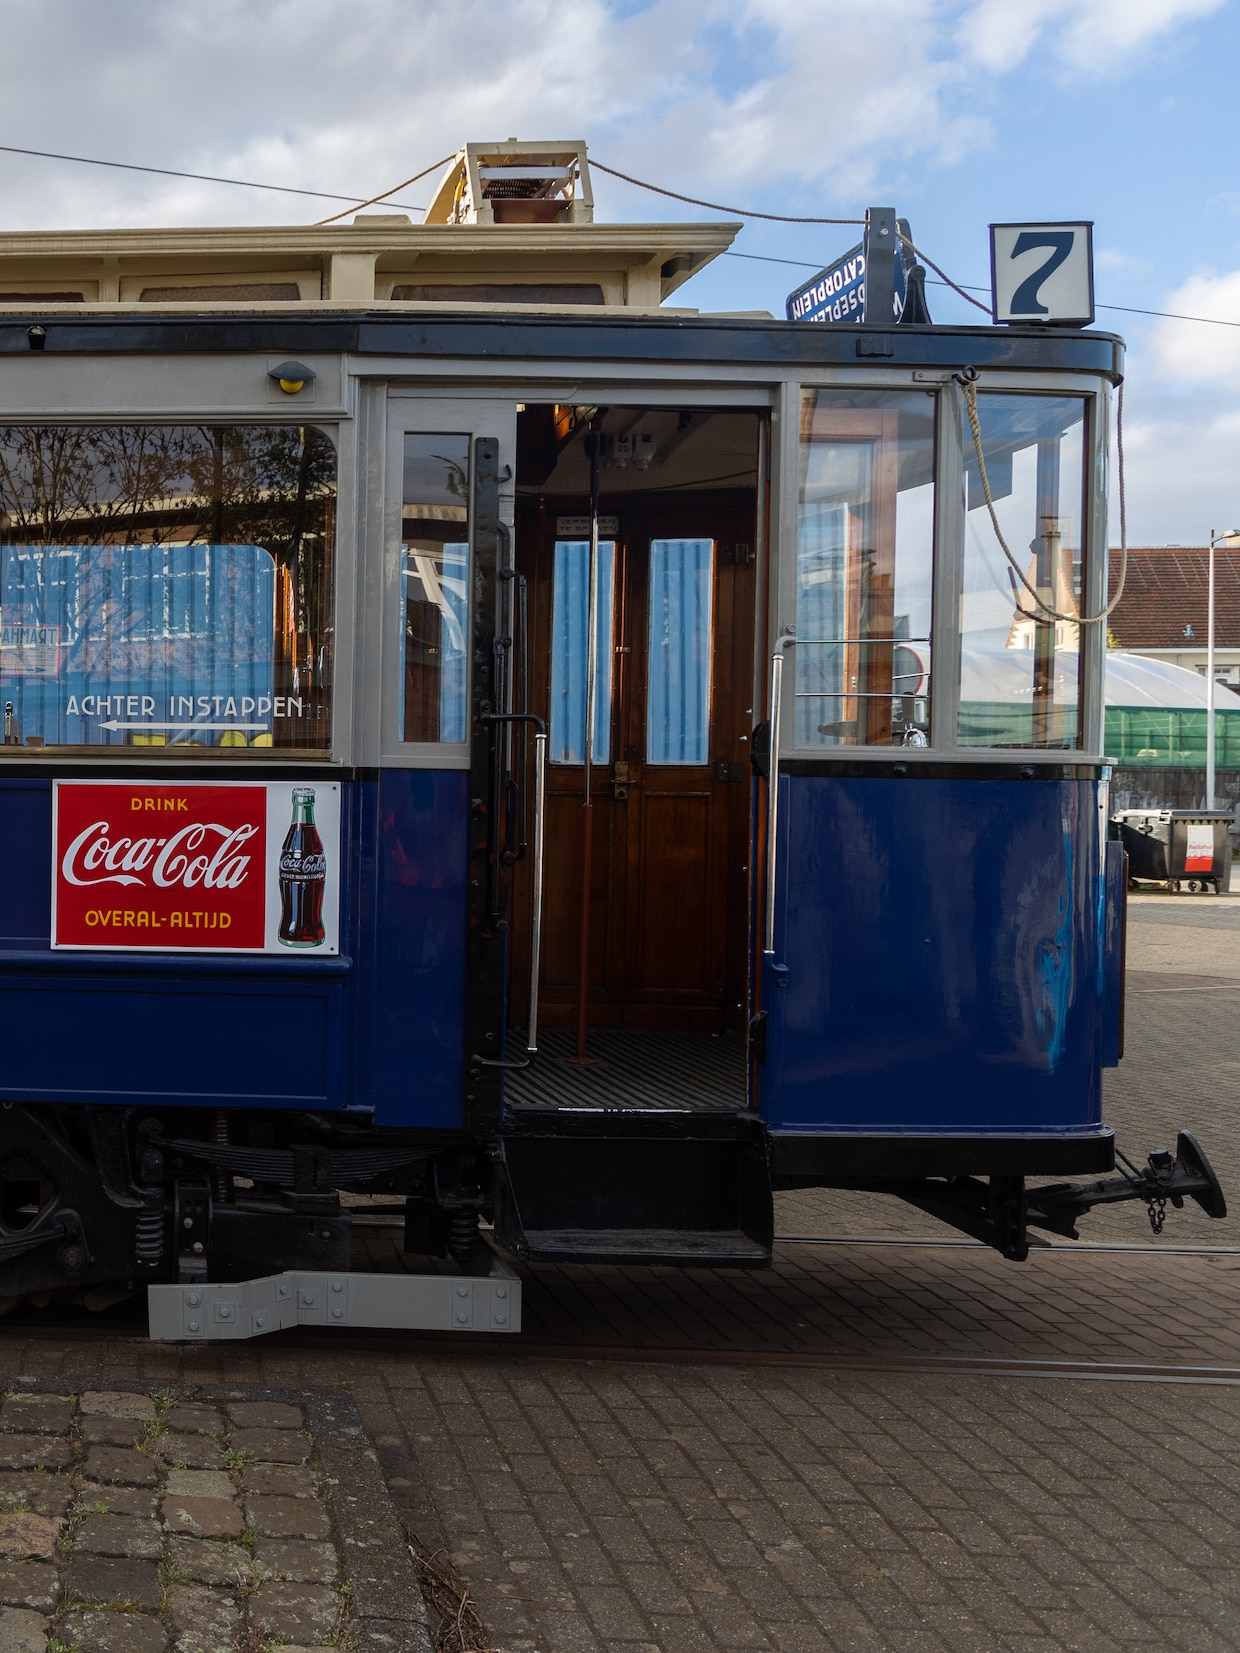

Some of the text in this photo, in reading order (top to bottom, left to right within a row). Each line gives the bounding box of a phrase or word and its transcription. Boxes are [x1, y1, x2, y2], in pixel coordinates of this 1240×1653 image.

[791, 255, 866, 319] CATORPLEIN
[1010, 231, 1075, 315] 7
[66, 695, 303, 719] ACHTER INSTAPPEN
[131, 798, 189, 811] DRINK
[61, 821, 260, 889] Coca-Cola
[85, 910, 232, 929] OVERAL-ALTIJD
